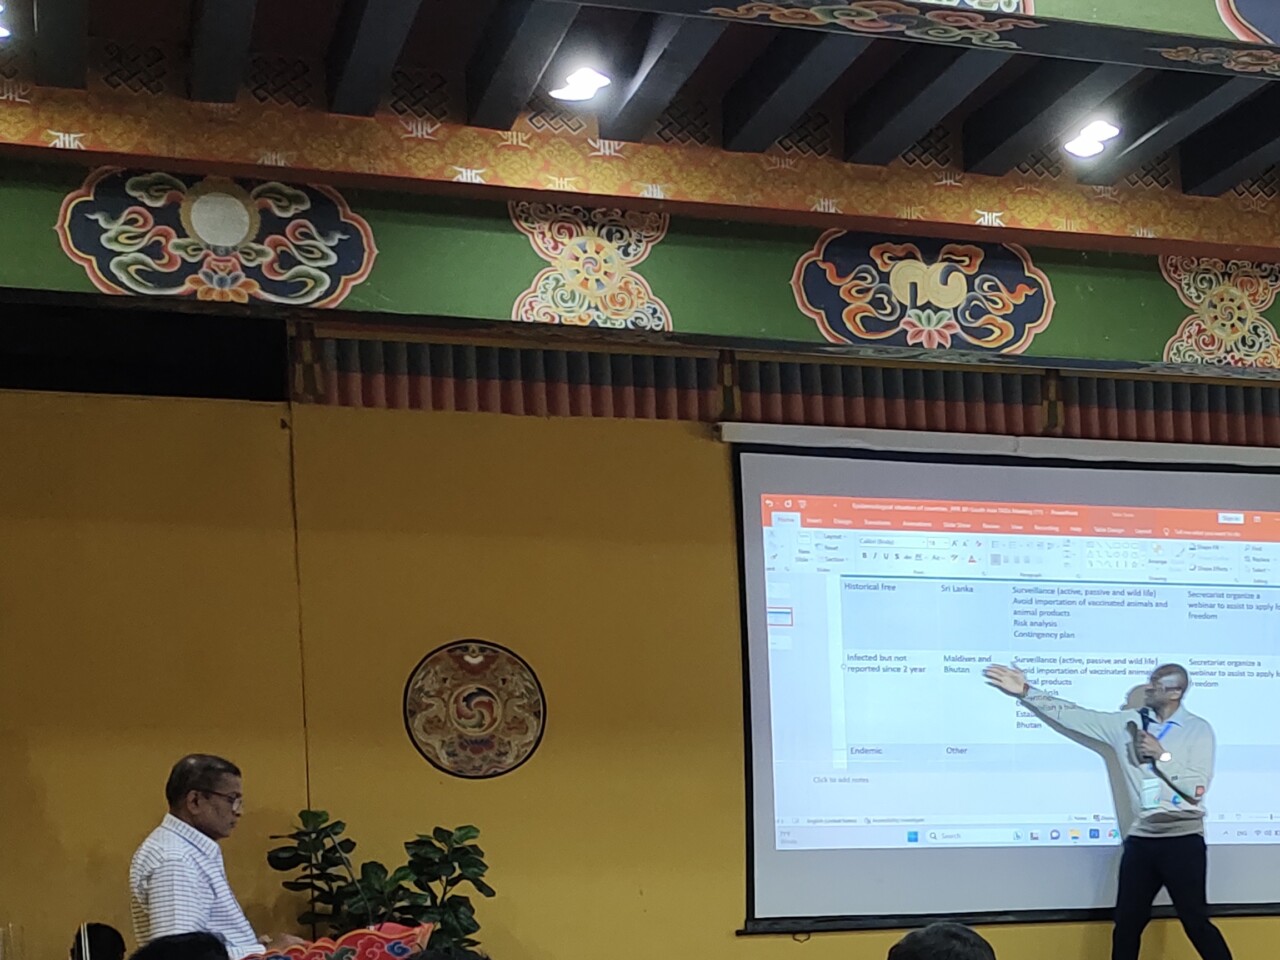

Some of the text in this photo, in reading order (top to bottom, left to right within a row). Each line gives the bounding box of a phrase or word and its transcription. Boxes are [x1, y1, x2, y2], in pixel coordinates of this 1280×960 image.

[1085, 588, 1110, 596] passive
[1039, 609, 1070, 618] products
[1030, 620, 1058, 628] analysis
[1014, 630, 1075, 640] Contingency plan
[847, 654, 878, 662] Infected
[880, 654, 892, 662] but
[978, 654, 992, 662] and
[1014, 656, 1057, 664] Surveillance
[848, 666, 880, 674] reported
[910, 666, 926, 674] year
[1080, 667, 1088, 675] of
[1041, 678, 1072, 686] products
[850, 747, 968, 755] Endemic Other
